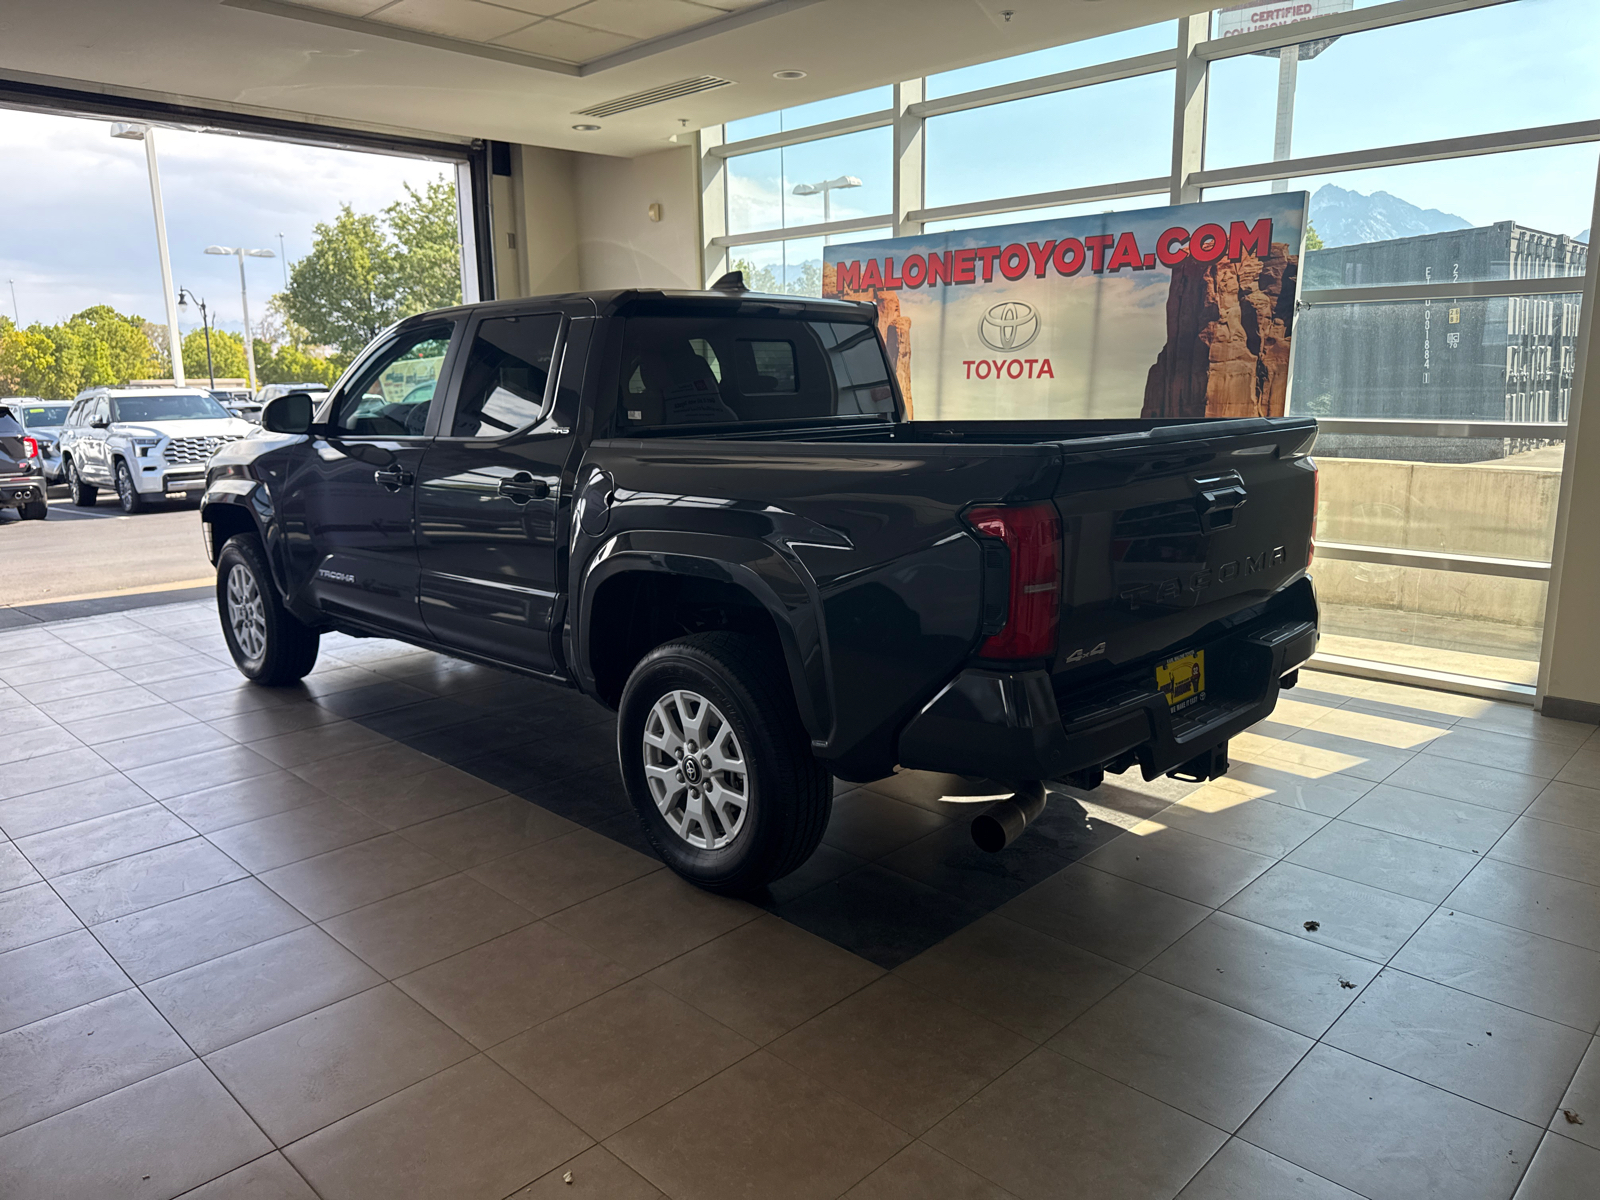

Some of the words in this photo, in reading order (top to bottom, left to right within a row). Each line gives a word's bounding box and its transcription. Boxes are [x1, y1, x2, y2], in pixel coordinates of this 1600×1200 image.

[1250, 4, 1312, 23] CERTIFIED
[836, 218, 1273, 292] MALONETOYOTA.COM
[963, 359, 1054, 380] TOYOTA
[318, 568, 355, 584] TACOMA
[1119, 544, 1286, 610] TACOMA
[1193, 666, 1198, 675] 32
